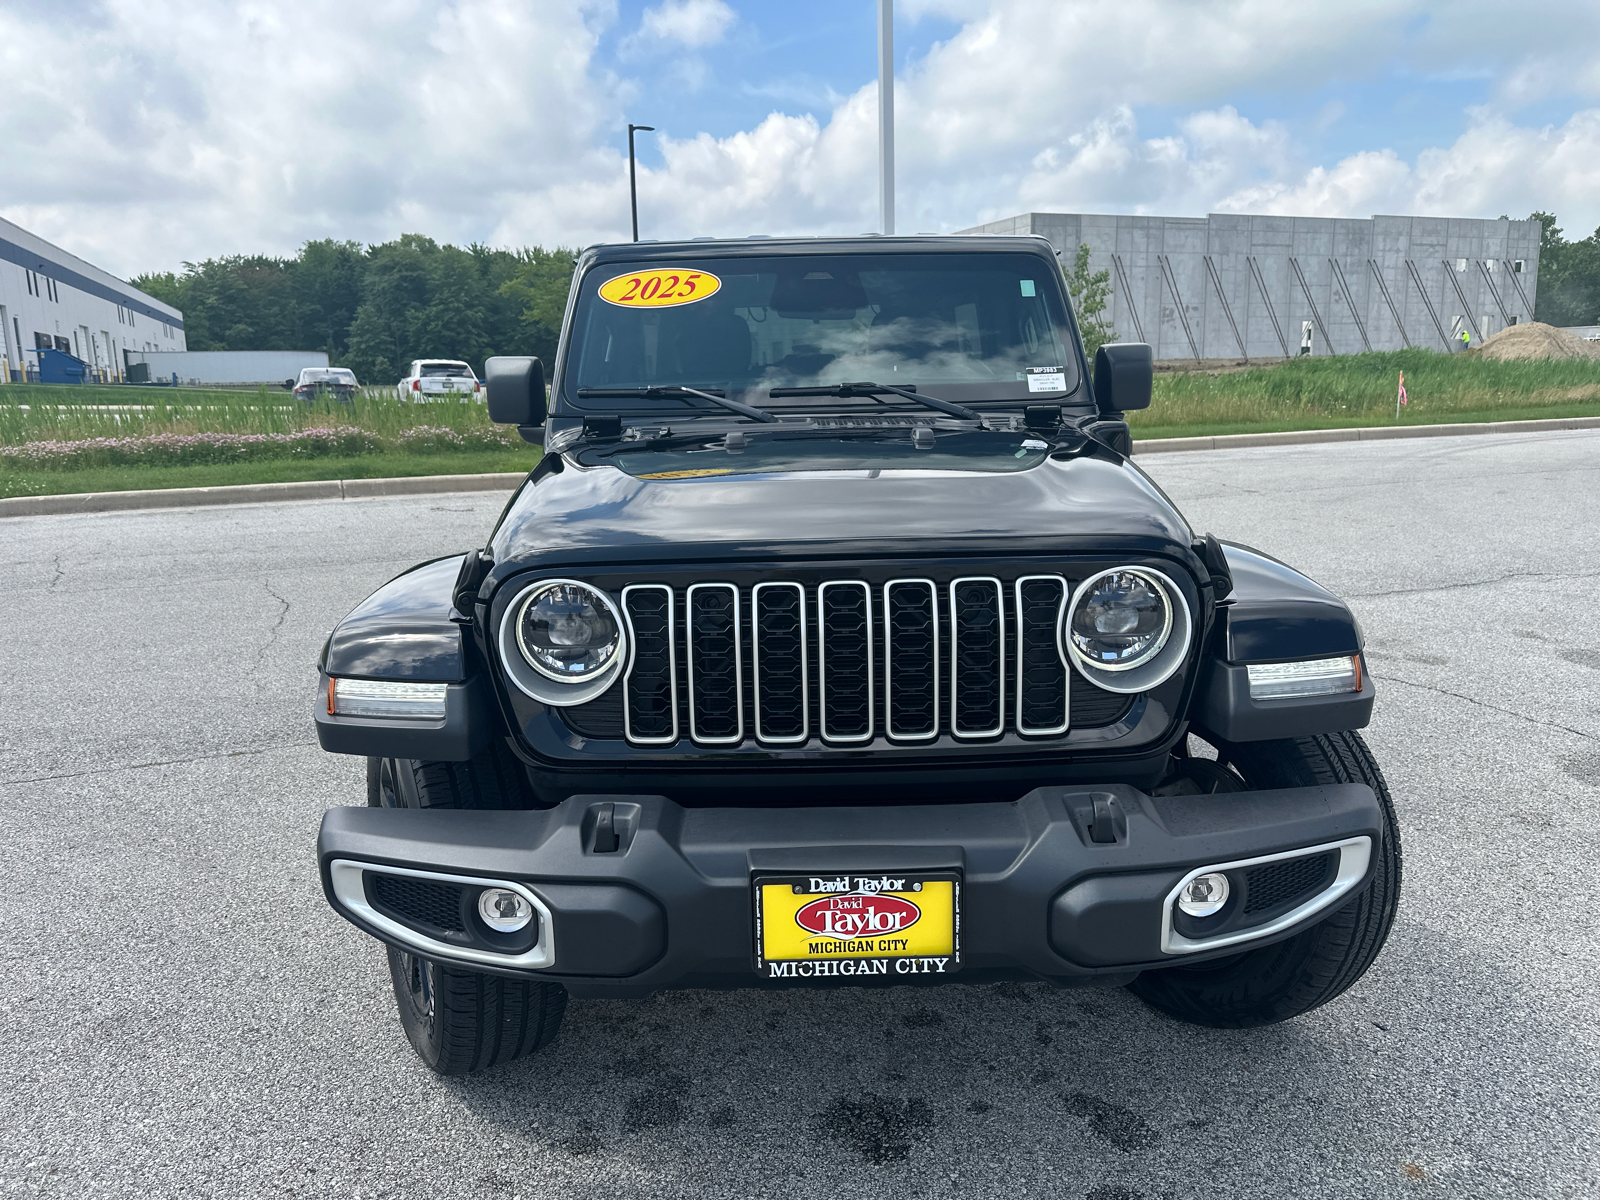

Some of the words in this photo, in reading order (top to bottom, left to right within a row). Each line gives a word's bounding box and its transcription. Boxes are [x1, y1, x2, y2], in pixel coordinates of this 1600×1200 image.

[618, 274, 702, 302] 2025
[809, 876, 850, 893] David
[852, 876, 906, 896] Taylor
[829, 897, 863, 910] David
[815, 906, 907, 936] Taylor
[808, 941, 874, 955] MICHIGAN
[878, 938, 909, 952] CITY
[769, 959, 889, 978] MICHIGAN
[895, 957, 949, 974] CITY
